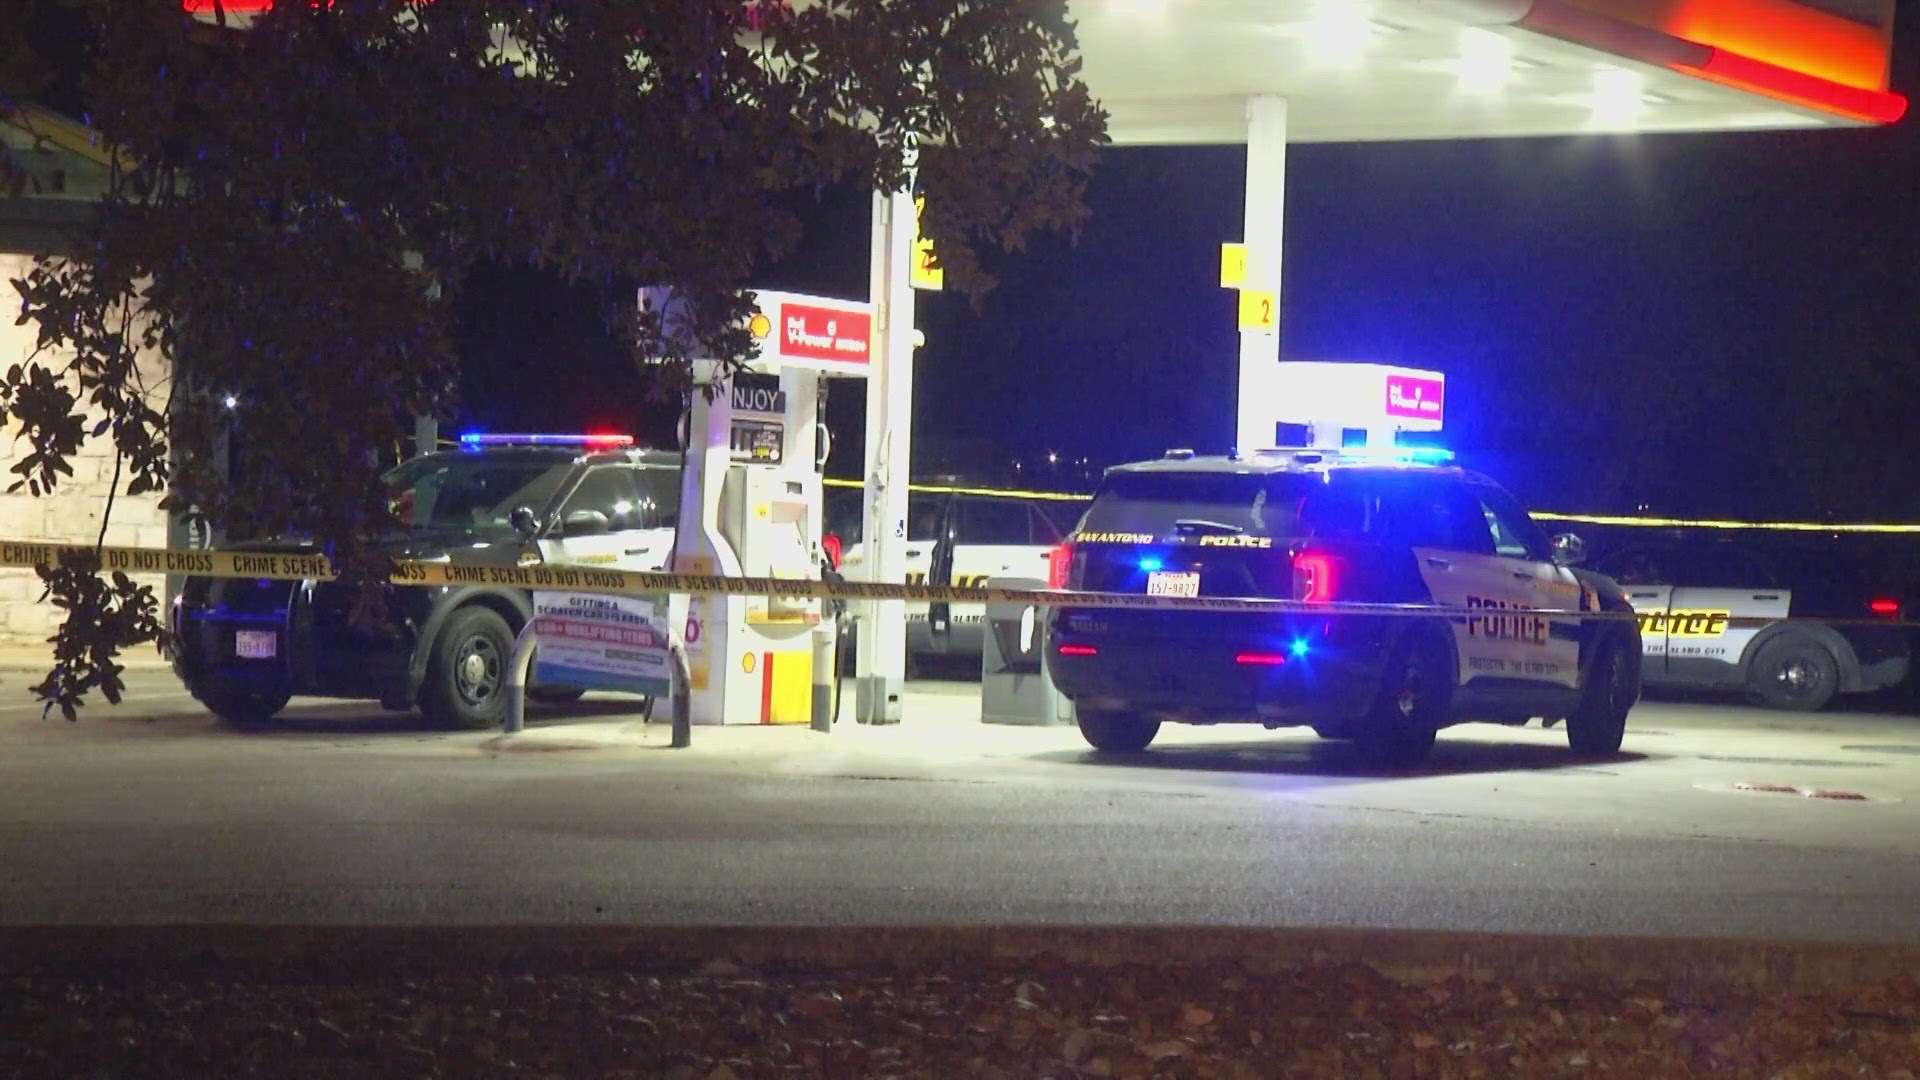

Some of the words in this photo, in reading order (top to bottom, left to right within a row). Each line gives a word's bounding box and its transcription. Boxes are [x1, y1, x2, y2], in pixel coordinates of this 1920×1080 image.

[1261, 299, 1270, 323] 2
[733, 387, 779, 411] NJOY
[1098, 532, 1154, 544] ANTONIO
[1200, 535, 1272, 548] POLICE
[3, 545, 51, 564] CRIME
[109, 551, 129, 568] DO
[134, 552, 160, 570] NOT
[167, 553, 213, 572] CROSS
[233, 555, 277, 574] CRIME
[283, 557, 326, 576] SCENE
[444, 565, 487, 581] CRIME
[490, 567, 531, 584] SCENE
[535, 569, 552, 584] DO
[556, 570, 580, 587] NOT
[584, 572, 625, 589] CROSS
[641, 573, 682, 589] CRIME
[687, 575, 725, 591] SCENE
[727, 577, 744, 592] DO
[746, 578, 769, 593] NOT
[773, 580, 813, 595] CROSS
[569, 597, 610, 610] GETTING
[1466, 595, 1546, 646] POLICE
[1670, 647, 1701, 655] ALAMO
